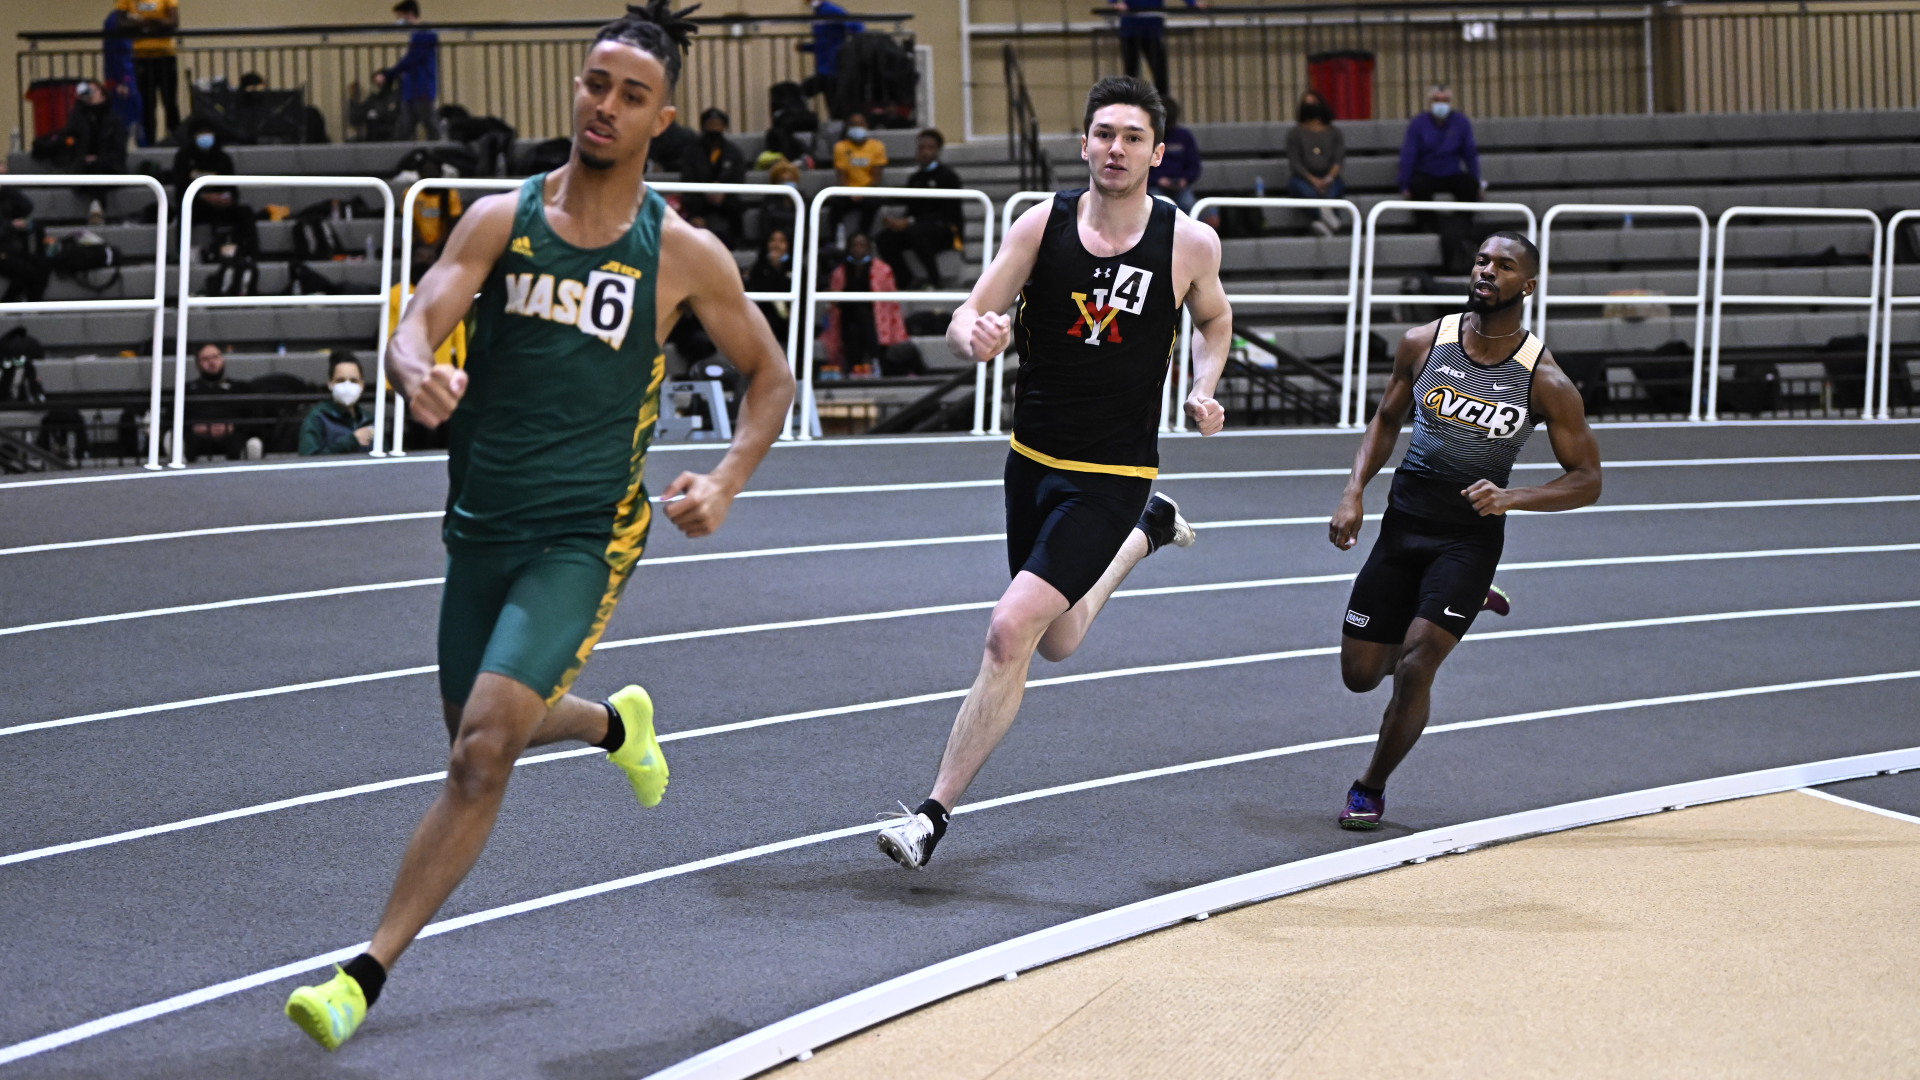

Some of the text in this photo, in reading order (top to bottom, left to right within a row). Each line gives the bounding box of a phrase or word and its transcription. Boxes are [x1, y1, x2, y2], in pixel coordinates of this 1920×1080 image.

[591, 278, 626, 331] 6
[1114, 271, 1144, 310] 4
[1494, 406, 1520, 437] 3
[1348, 613, 1366, 625] RAMS
